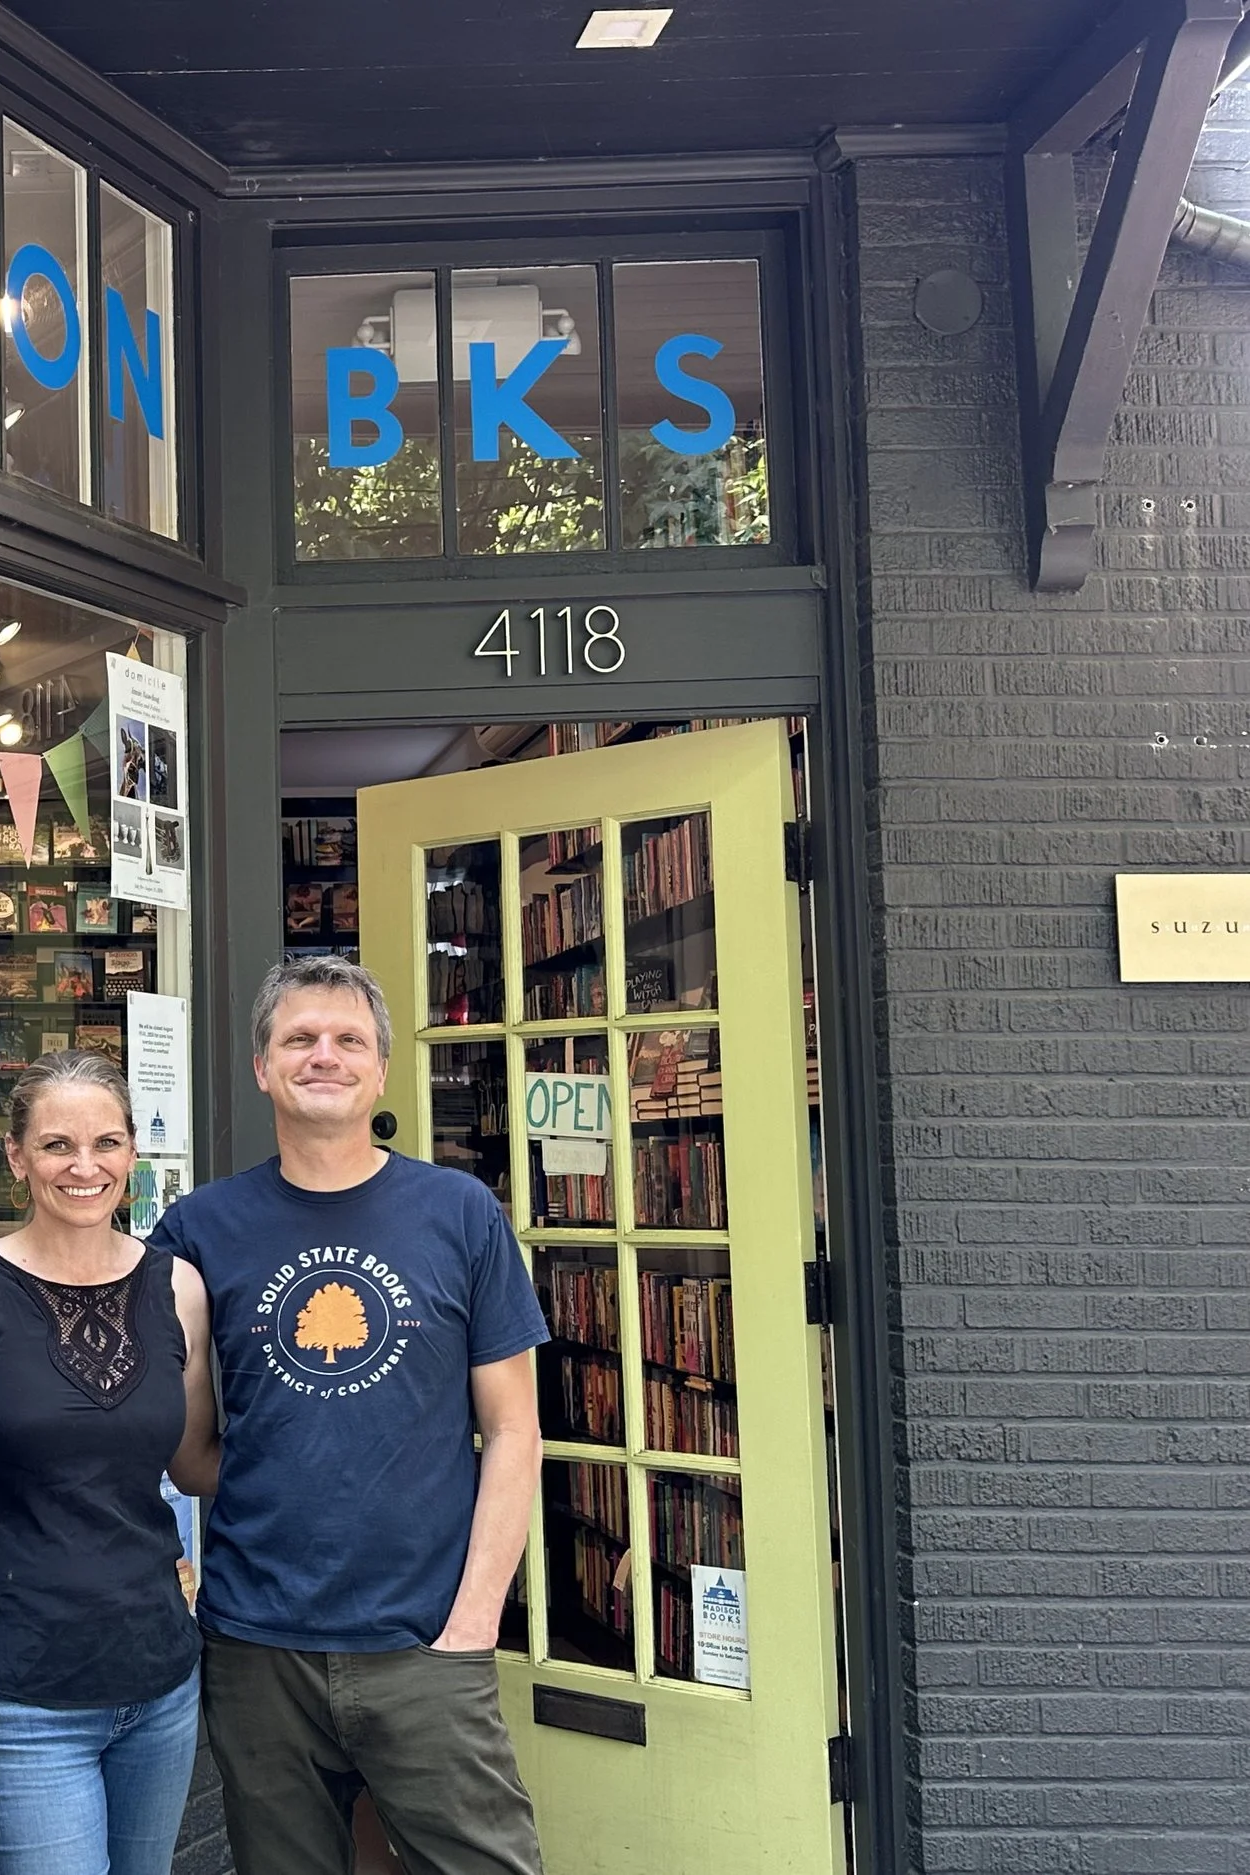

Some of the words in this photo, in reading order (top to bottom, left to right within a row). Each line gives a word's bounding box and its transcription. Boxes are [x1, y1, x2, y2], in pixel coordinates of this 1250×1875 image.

[326, 333, 737, 468] BKS
[474, 604, 626, 678] 4118
[124, 668, 166, 690] domicile
[1151, 921, 1239, 934] suzu
[633, 984, 662, 1000] WITCH
[526, 1078, 612, 1131] OPEN
[134, 1202, 158, 1230] CLUB
[257, 1263, 296, 1315] SOLID
[298, 1246, 359, 1268] STATE
[360, 1253, 412, 1309] BOOKS
[252, 1326, 272, 1334] EST.
[397, 1320, 422, 1328] 2017
[262, 1343, 315, 1396] DISTRICT
[320, 1387, 334, 1400] of
[338, 1338, 408, 1397] COLUMBIA
[702, 1604, 740, 1616] MADISON
[702, 1612, 740, 1624] BOOKS
[698, 1632, 721, 1641] STORE
[722, 1635, 746, 1644] HOURS
